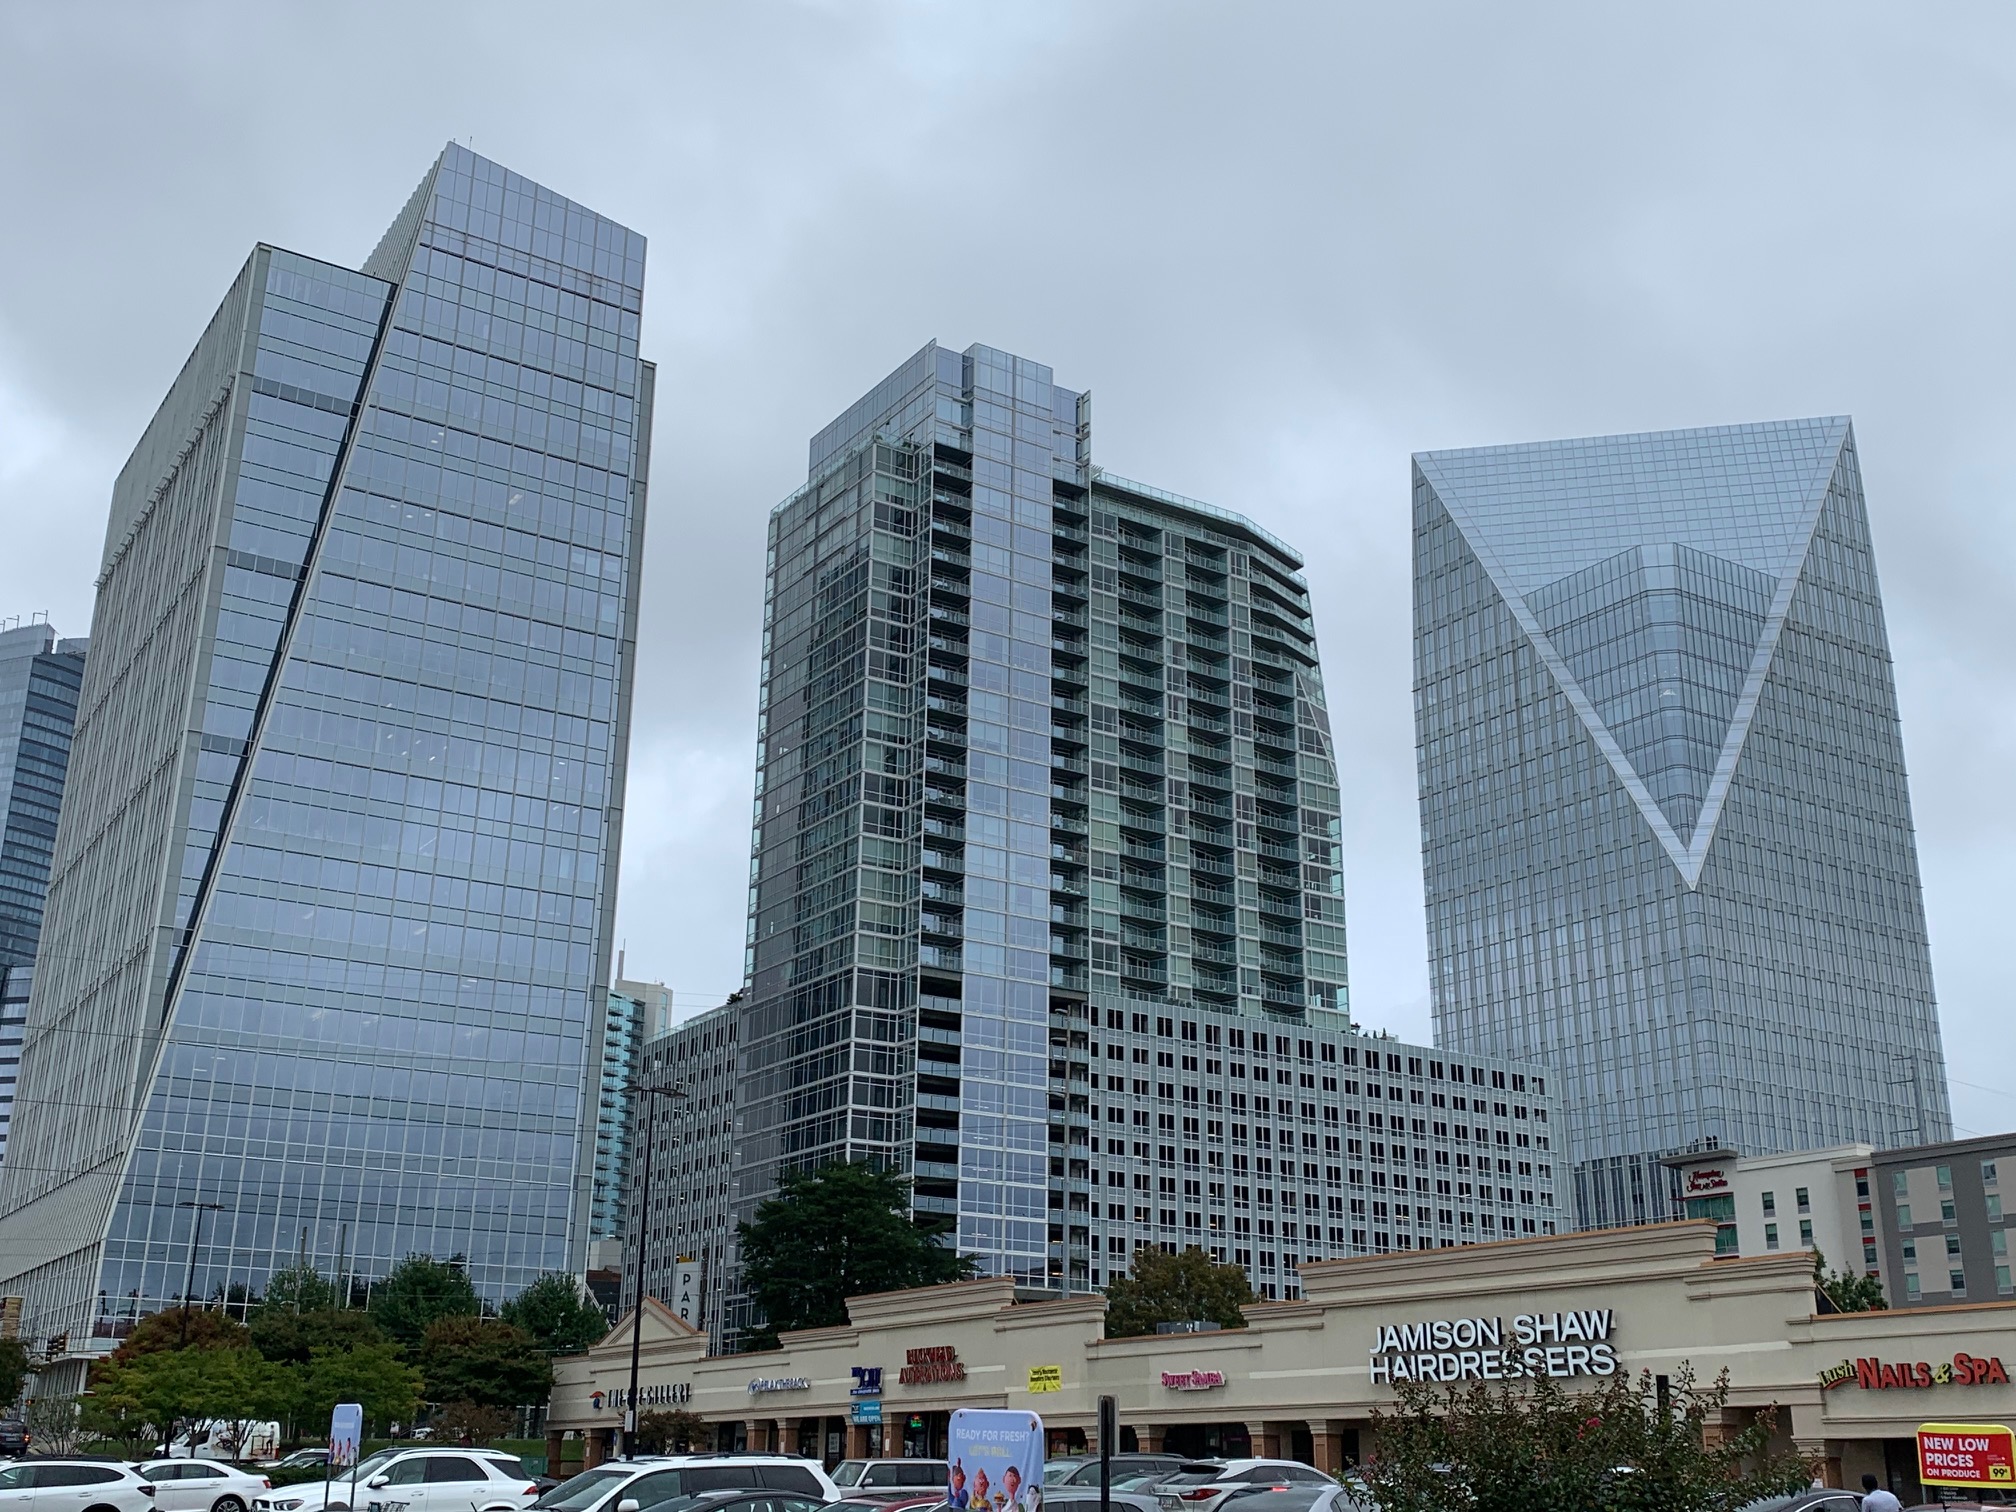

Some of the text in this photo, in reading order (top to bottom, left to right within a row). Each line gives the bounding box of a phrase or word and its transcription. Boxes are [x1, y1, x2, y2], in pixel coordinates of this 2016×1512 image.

[1369, 1309, 1612, 1354] JAMISON SHAW
[1369, 1344, 1617, 1384] HAIRDRESSERS
[1817, 1359, 1855, 1387] Lush
[1934, 1363, 1951, 1384] &
[956, 1428, 1030, 1442] READY FOR FRESH?
[1923, 1436, 1989, 1452] NEW LOW
[1925, 1452, 1974, 1468] PRICES
[1926, 1468, 1981, 1479] ON PRODUCE
